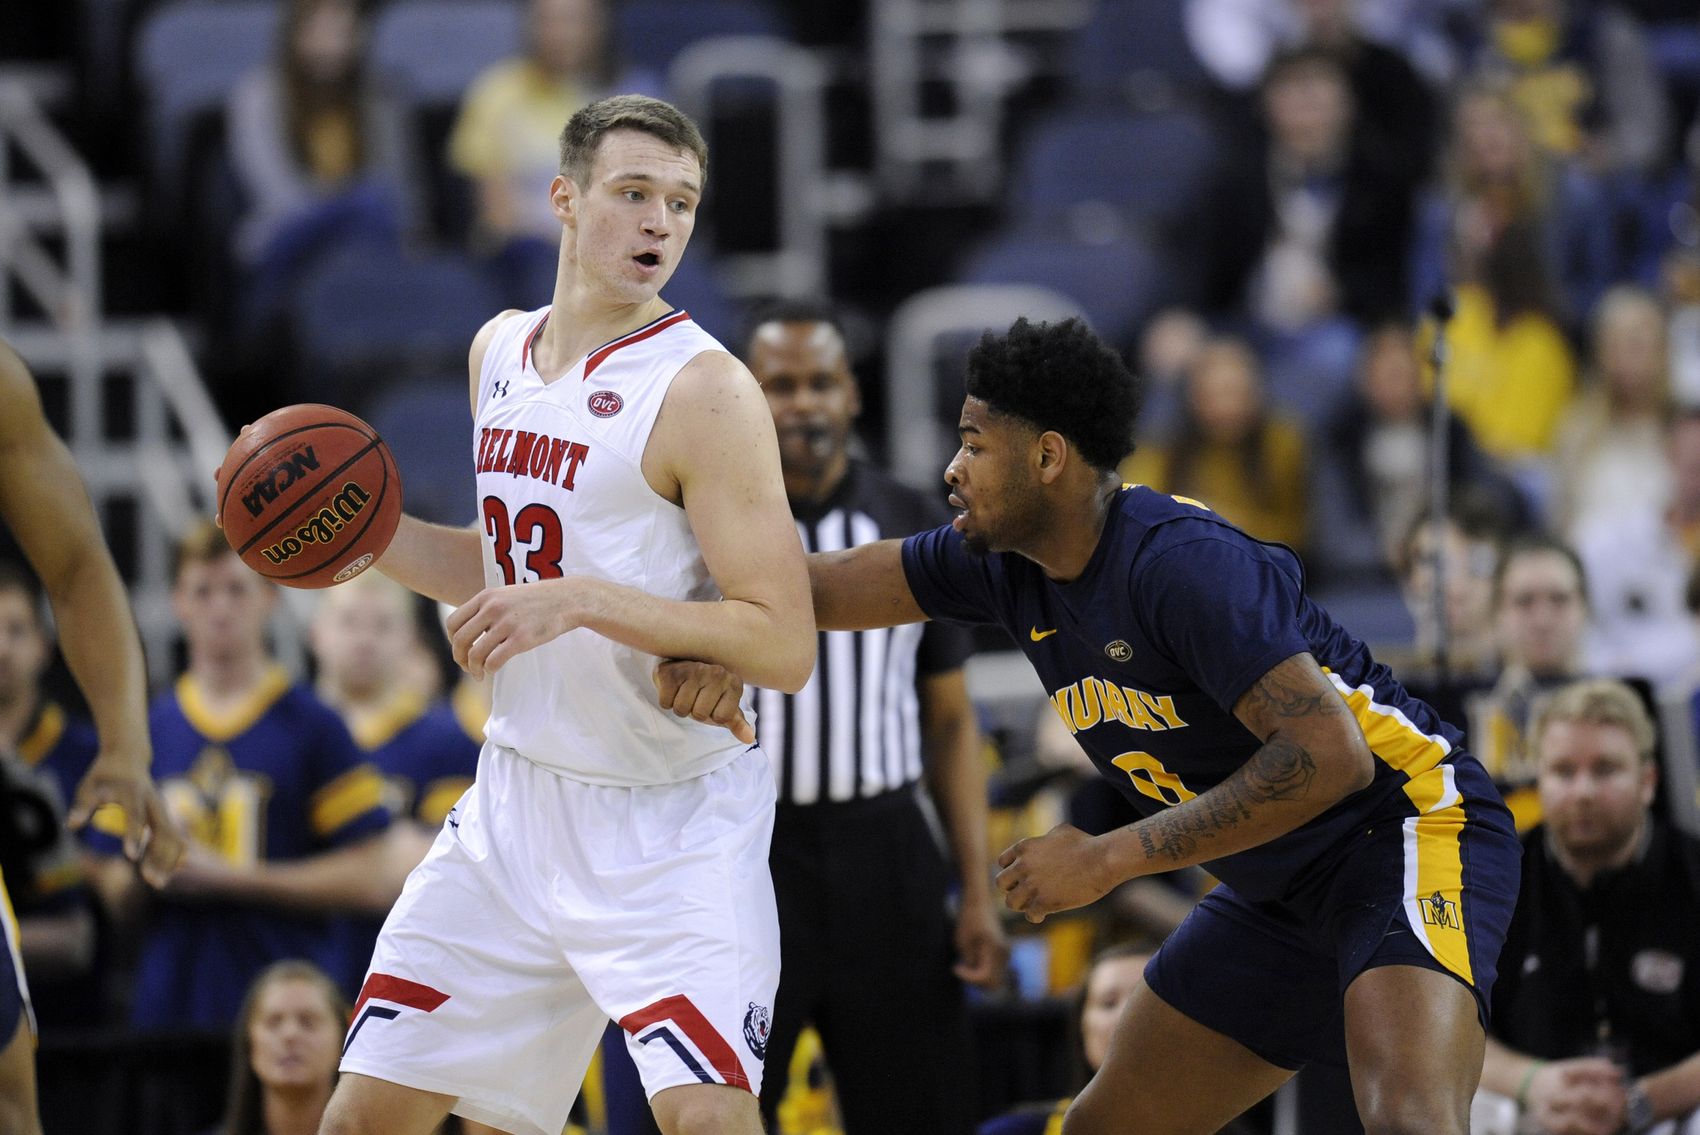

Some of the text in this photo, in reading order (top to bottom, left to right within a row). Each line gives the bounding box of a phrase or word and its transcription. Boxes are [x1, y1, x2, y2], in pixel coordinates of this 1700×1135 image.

[242, 445, 320, 519] NCAA
[476, 427, 590, 492] BELMONT
[261, 481, 372, 565] Wilson
[483, 495, 565, 585] 33
